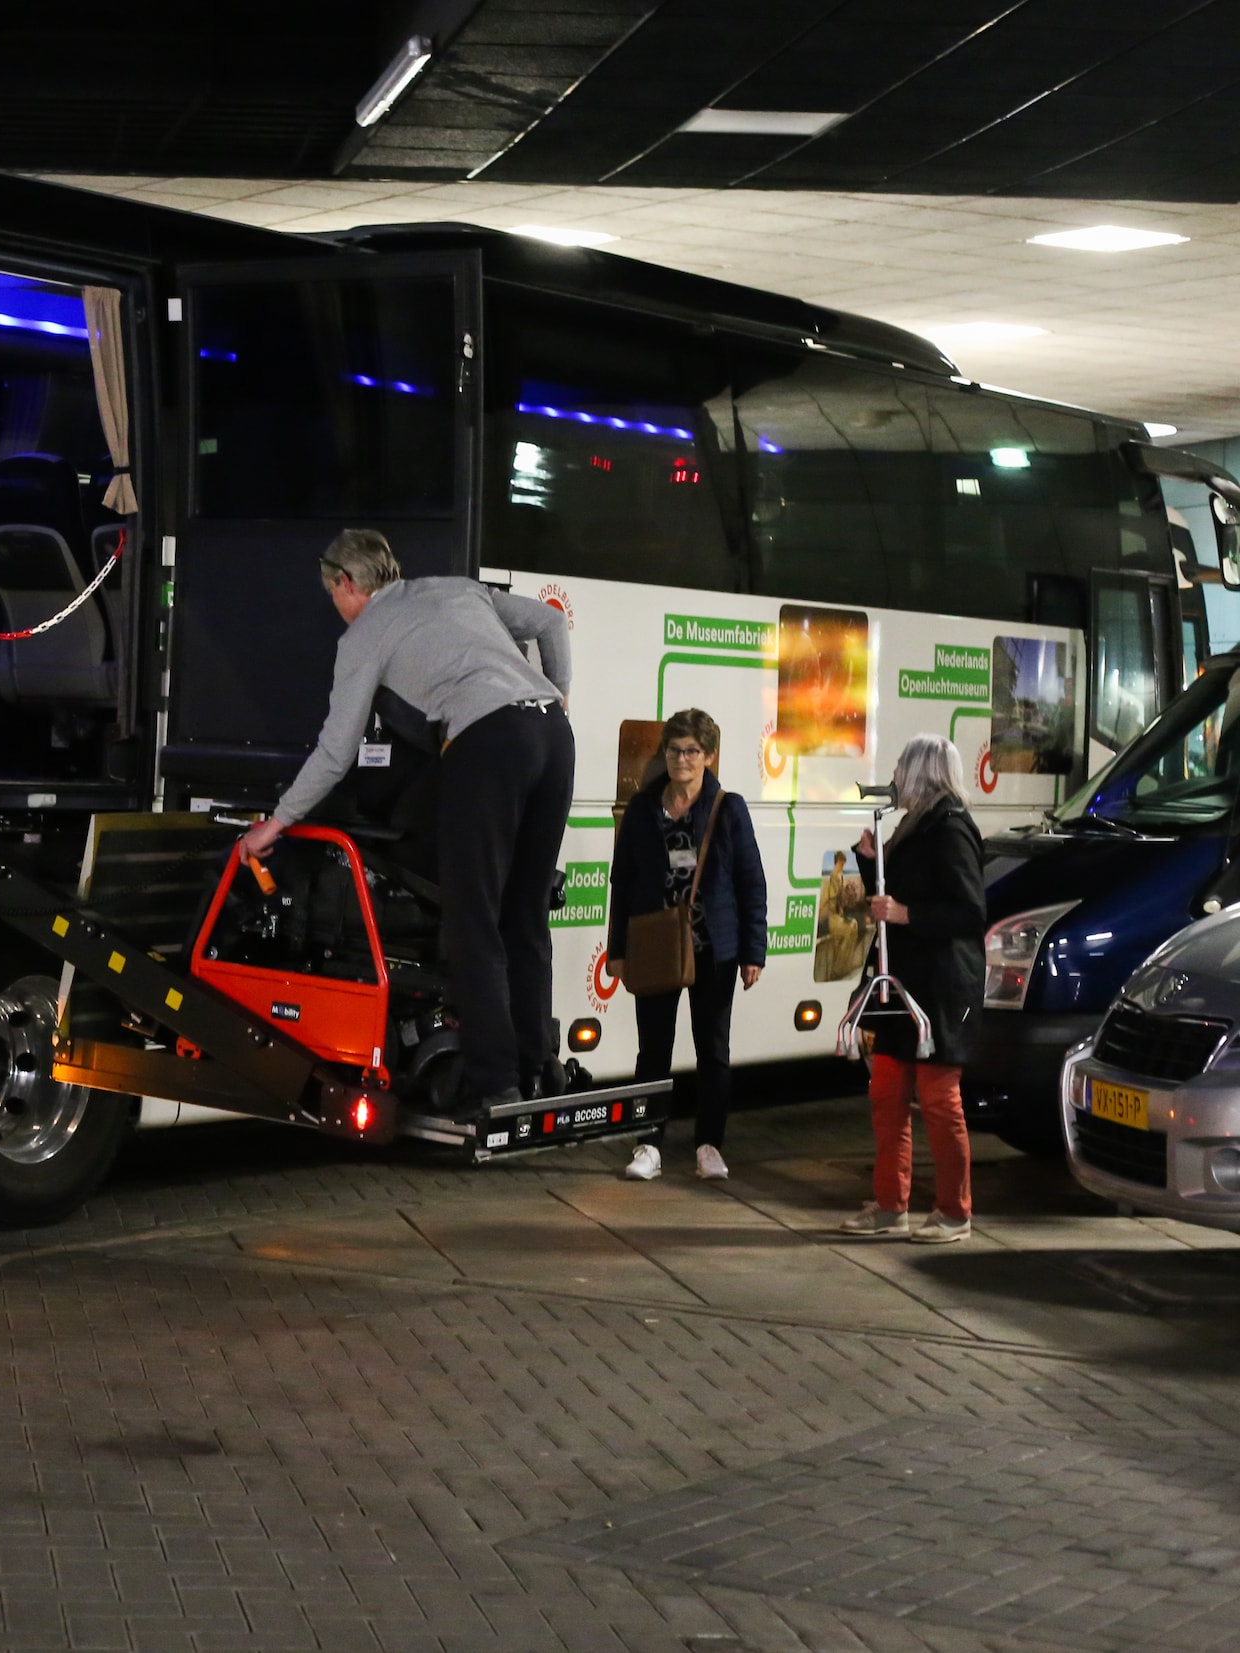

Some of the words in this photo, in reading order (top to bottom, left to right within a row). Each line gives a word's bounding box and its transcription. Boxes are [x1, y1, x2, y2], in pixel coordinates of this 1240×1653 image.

[538, 584, 575, 631] IDDELBURG
[667, 619, 683, 640] De
[686, 620, 774, 646] Museumfabriek
[937, 649, 989, 671] Nederlands
[901, 674, 988, 697] Openluchtmuseum
[568, 867, 605, 888] Joods
[549, 903, 603, 922] Museum
[788, 900, 813, 919] Fries
[767, 931, 811, 950] Museum
[586, 941, 608, 1014] AMSTERDAM
[574, 1106, 607, 1122] access
[1096, 1086, 1141, 1121] VX-151-P
